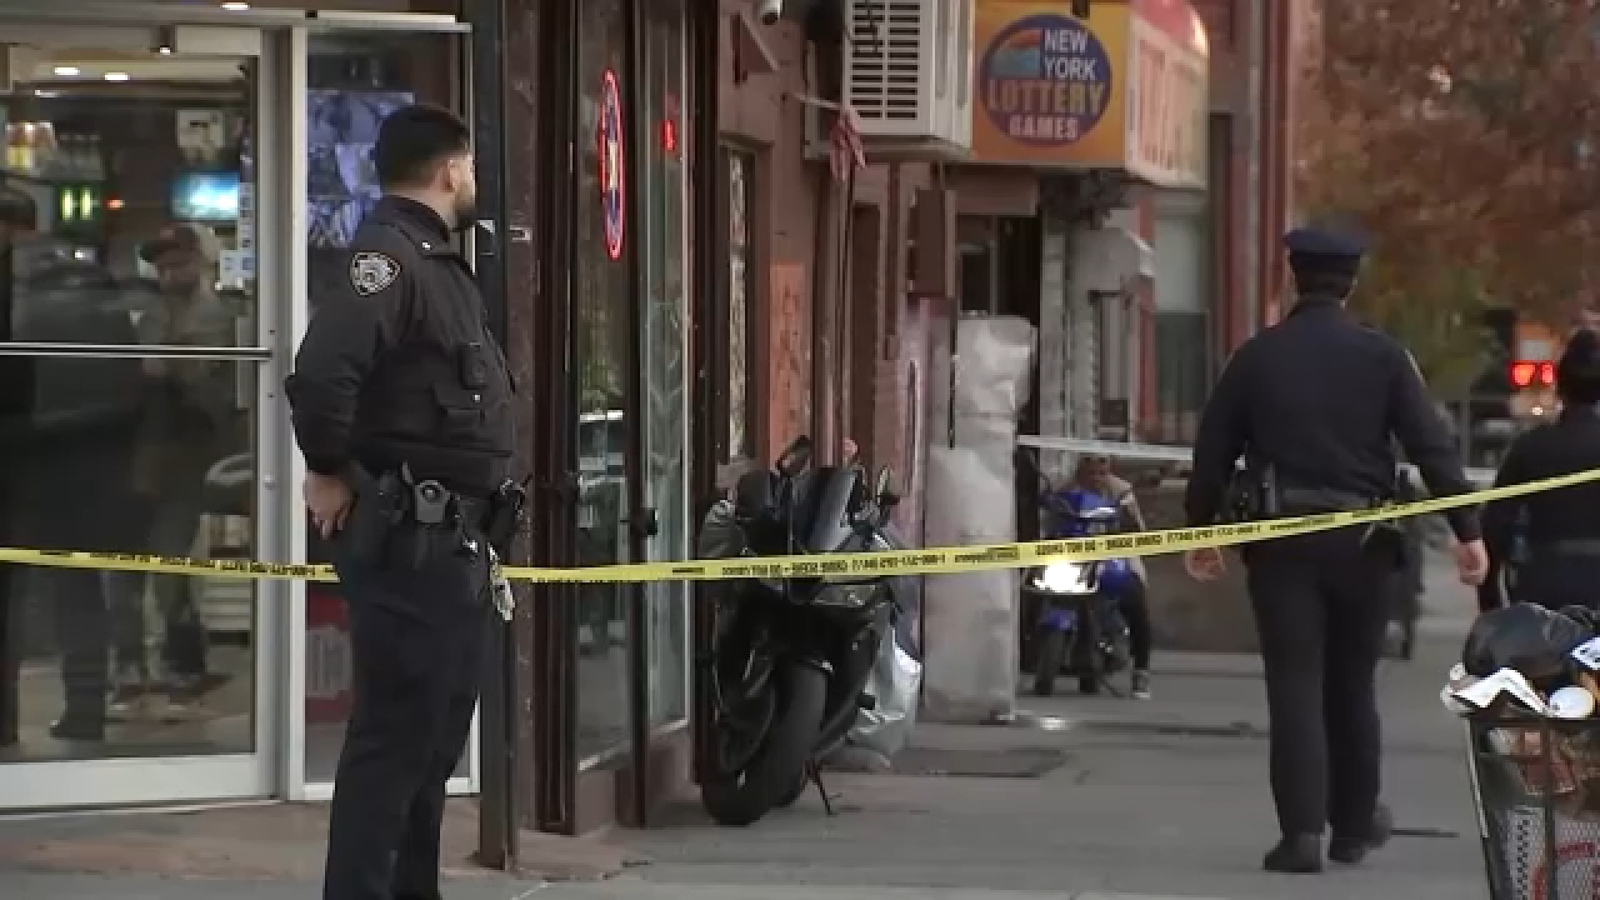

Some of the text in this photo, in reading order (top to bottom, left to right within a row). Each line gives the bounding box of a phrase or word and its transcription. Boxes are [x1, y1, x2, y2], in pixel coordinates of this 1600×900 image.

[1044, 29, 1089, 54] NEW
[1044, 56, 1096, 81] YORK
[988, 78, 1106, 116] LOTTERY
[1008, 114, 1079, 141] GAMES
